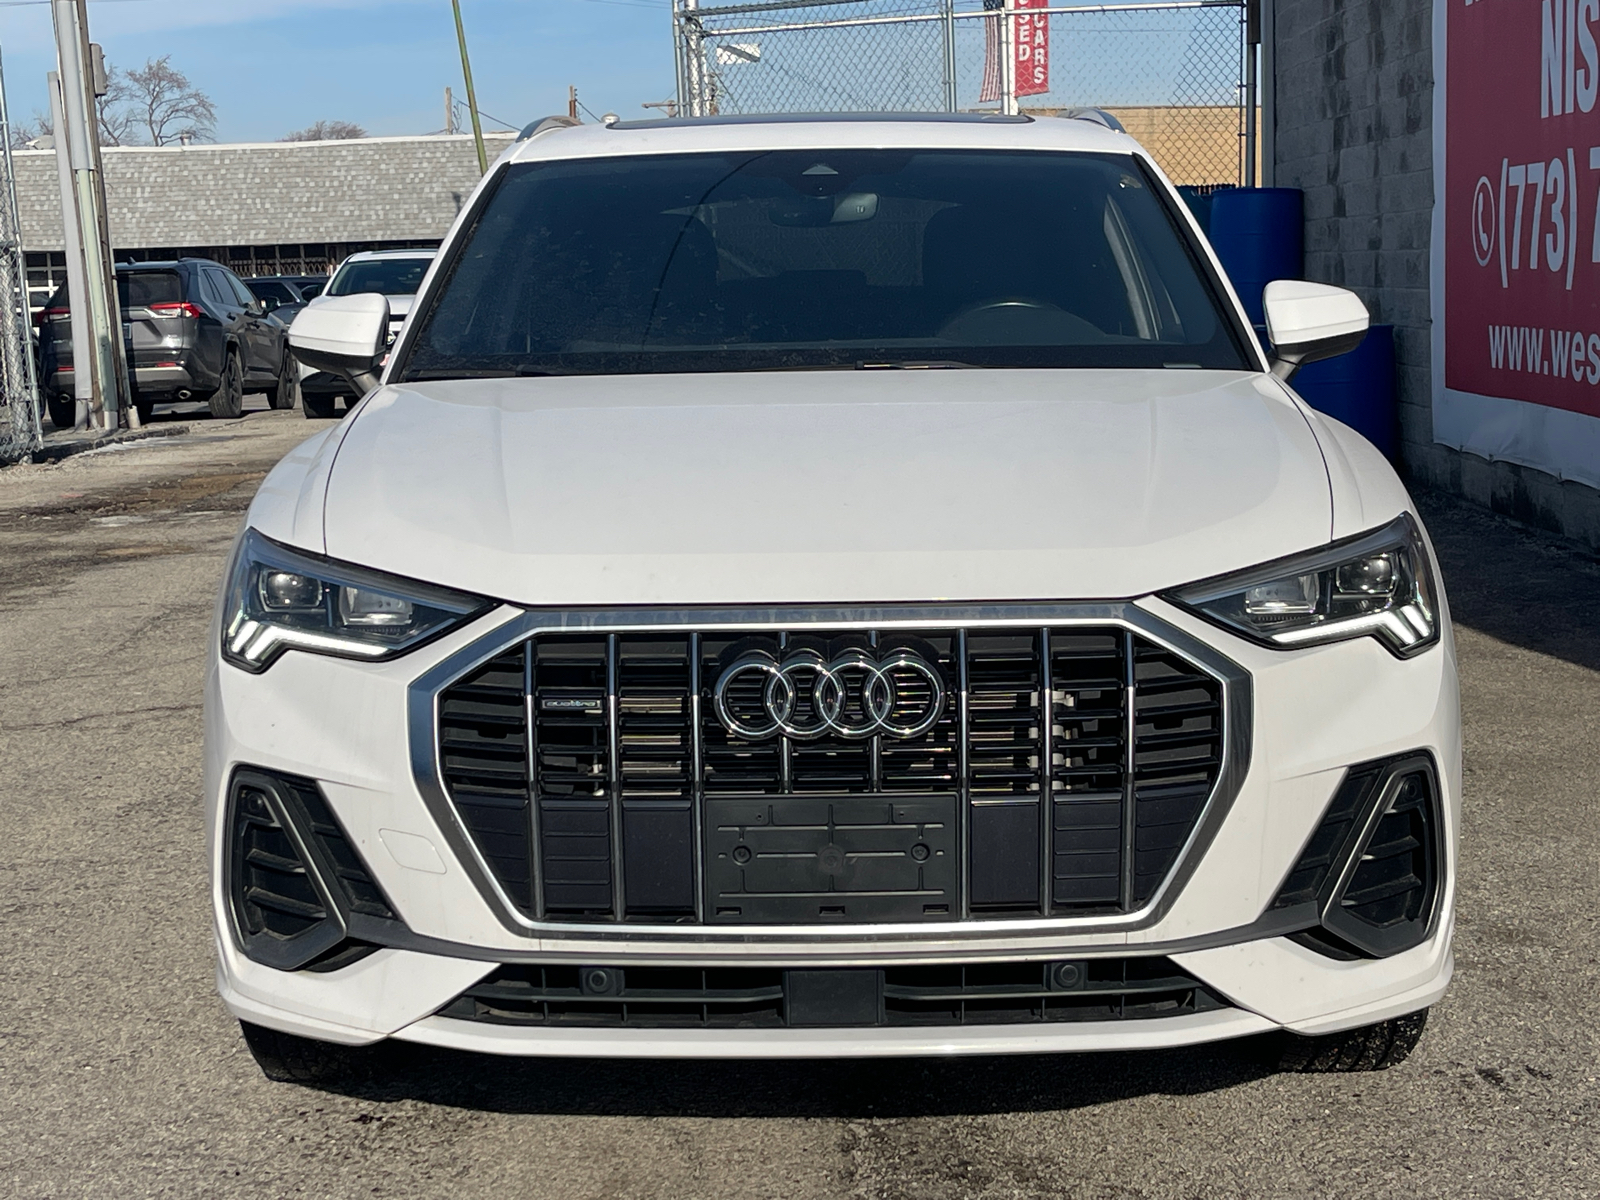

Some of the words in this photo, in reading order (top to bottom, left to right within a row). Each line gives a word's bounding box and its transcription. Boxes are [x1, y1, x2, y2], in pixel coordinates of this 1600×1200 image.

[1018, 0, 1031, 61] SED
[1033, 10, 1046, 84] CARS
[1541, 0, 1600, 119] NIS
[1499, 147, 1578, 291] (773)
[1488, 324, 1600, 386] www.wes
